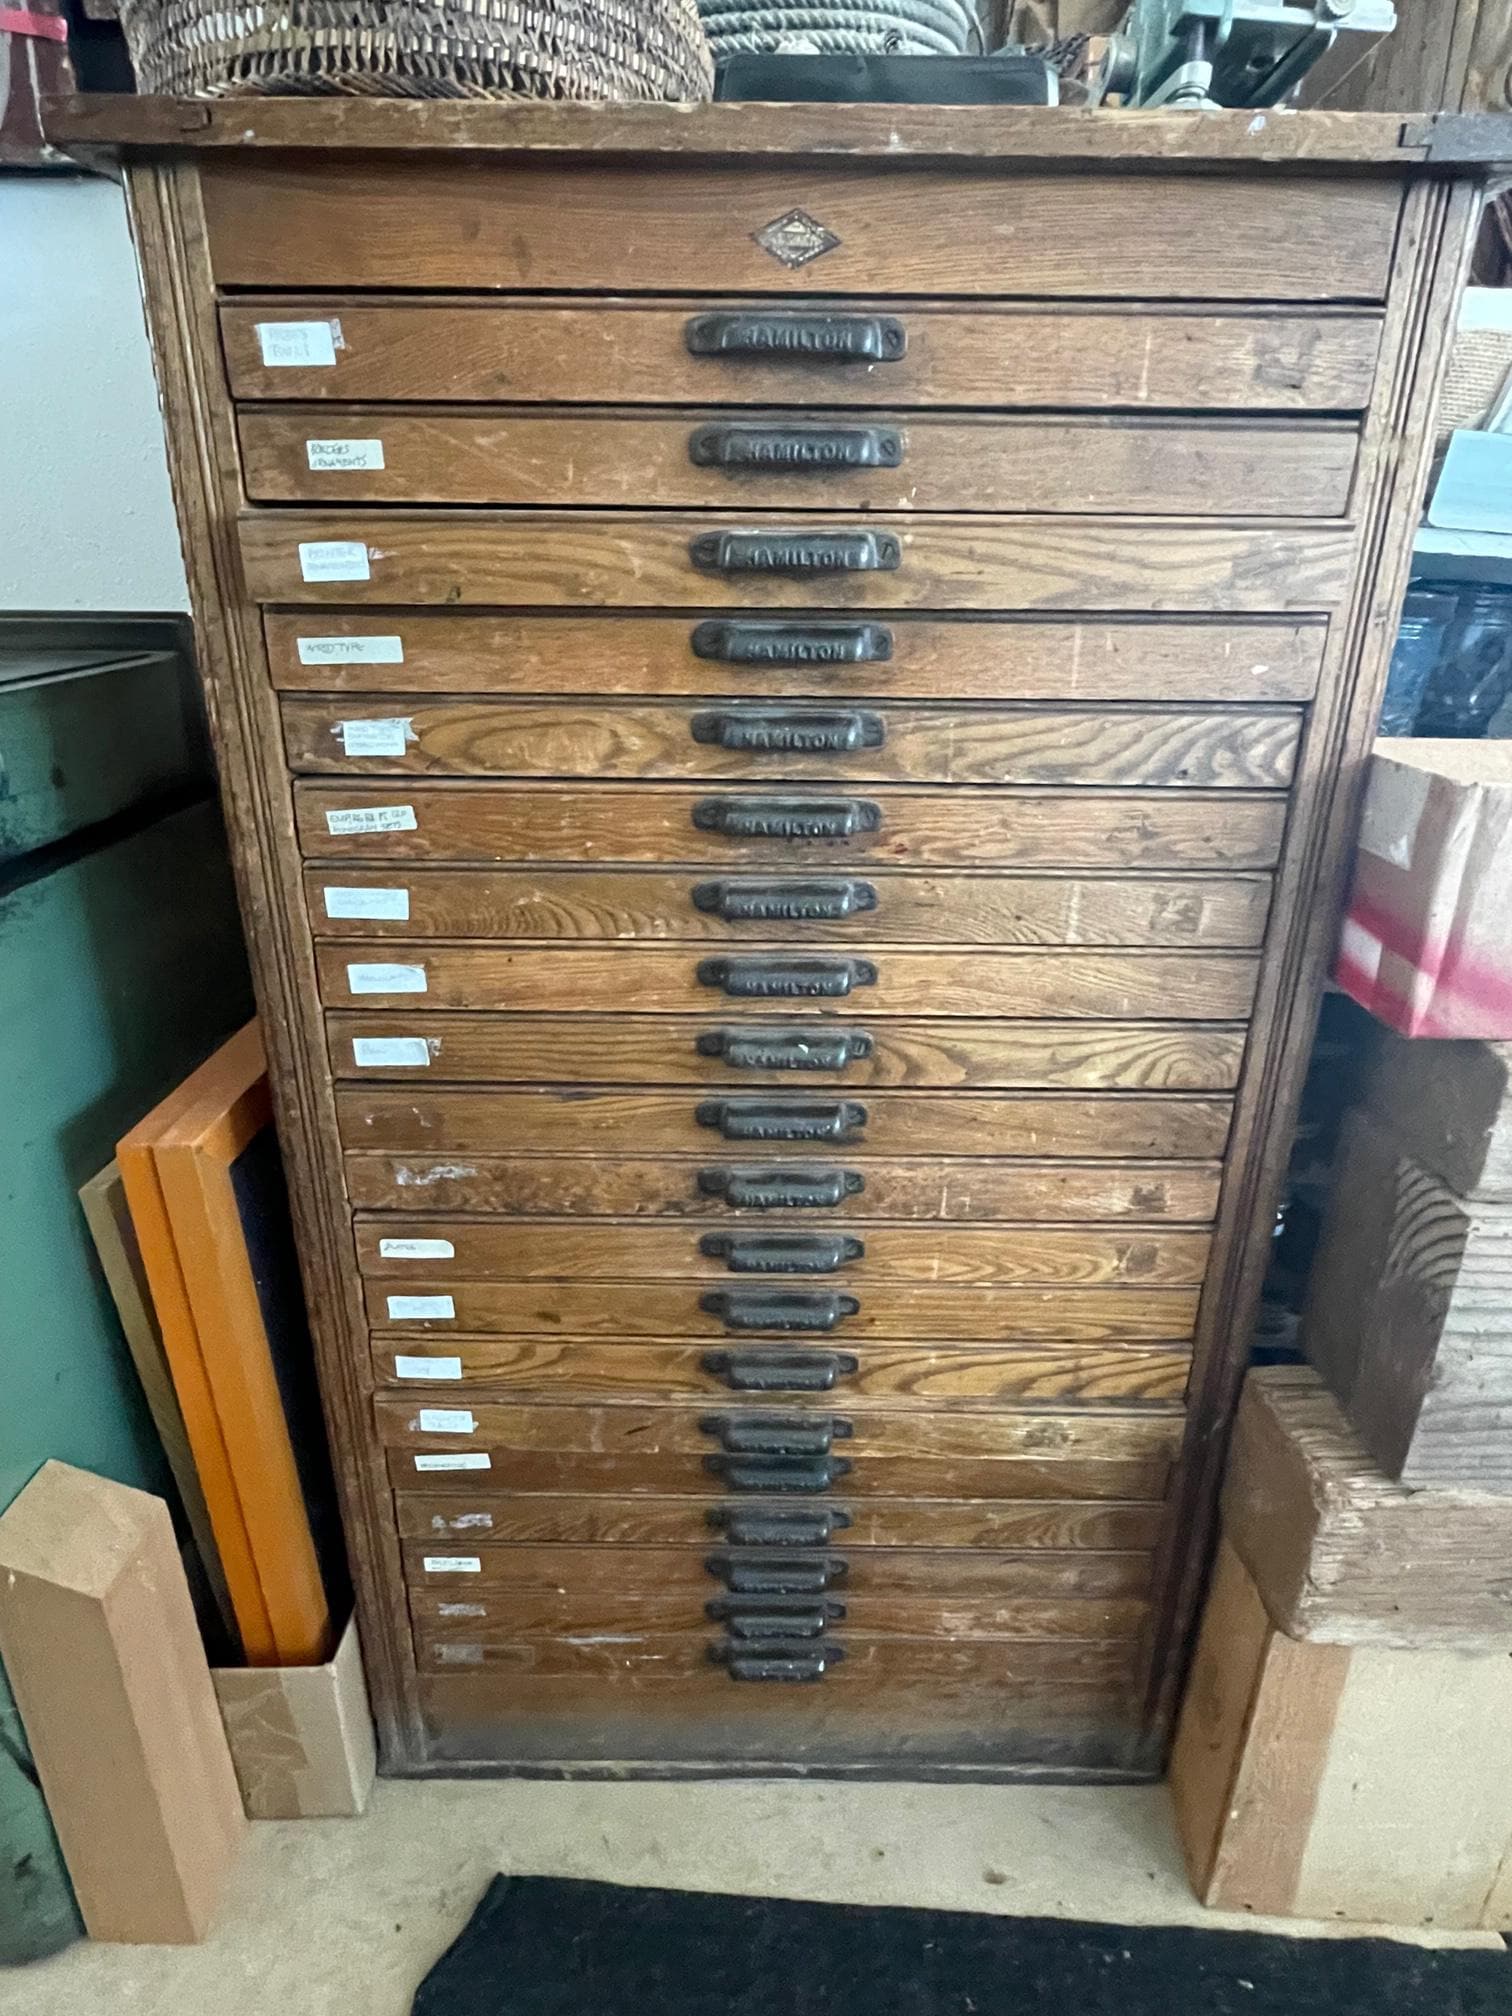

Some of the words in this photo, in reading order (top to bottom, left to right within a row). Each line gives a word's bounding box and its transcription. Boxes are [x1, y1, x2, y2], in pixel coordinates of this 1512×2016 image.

[744, 324, 853, 349] HAMILTON
[747, 546, 850, 569] HAMILTON
[748, 642, 846, 660] HAMILTON
